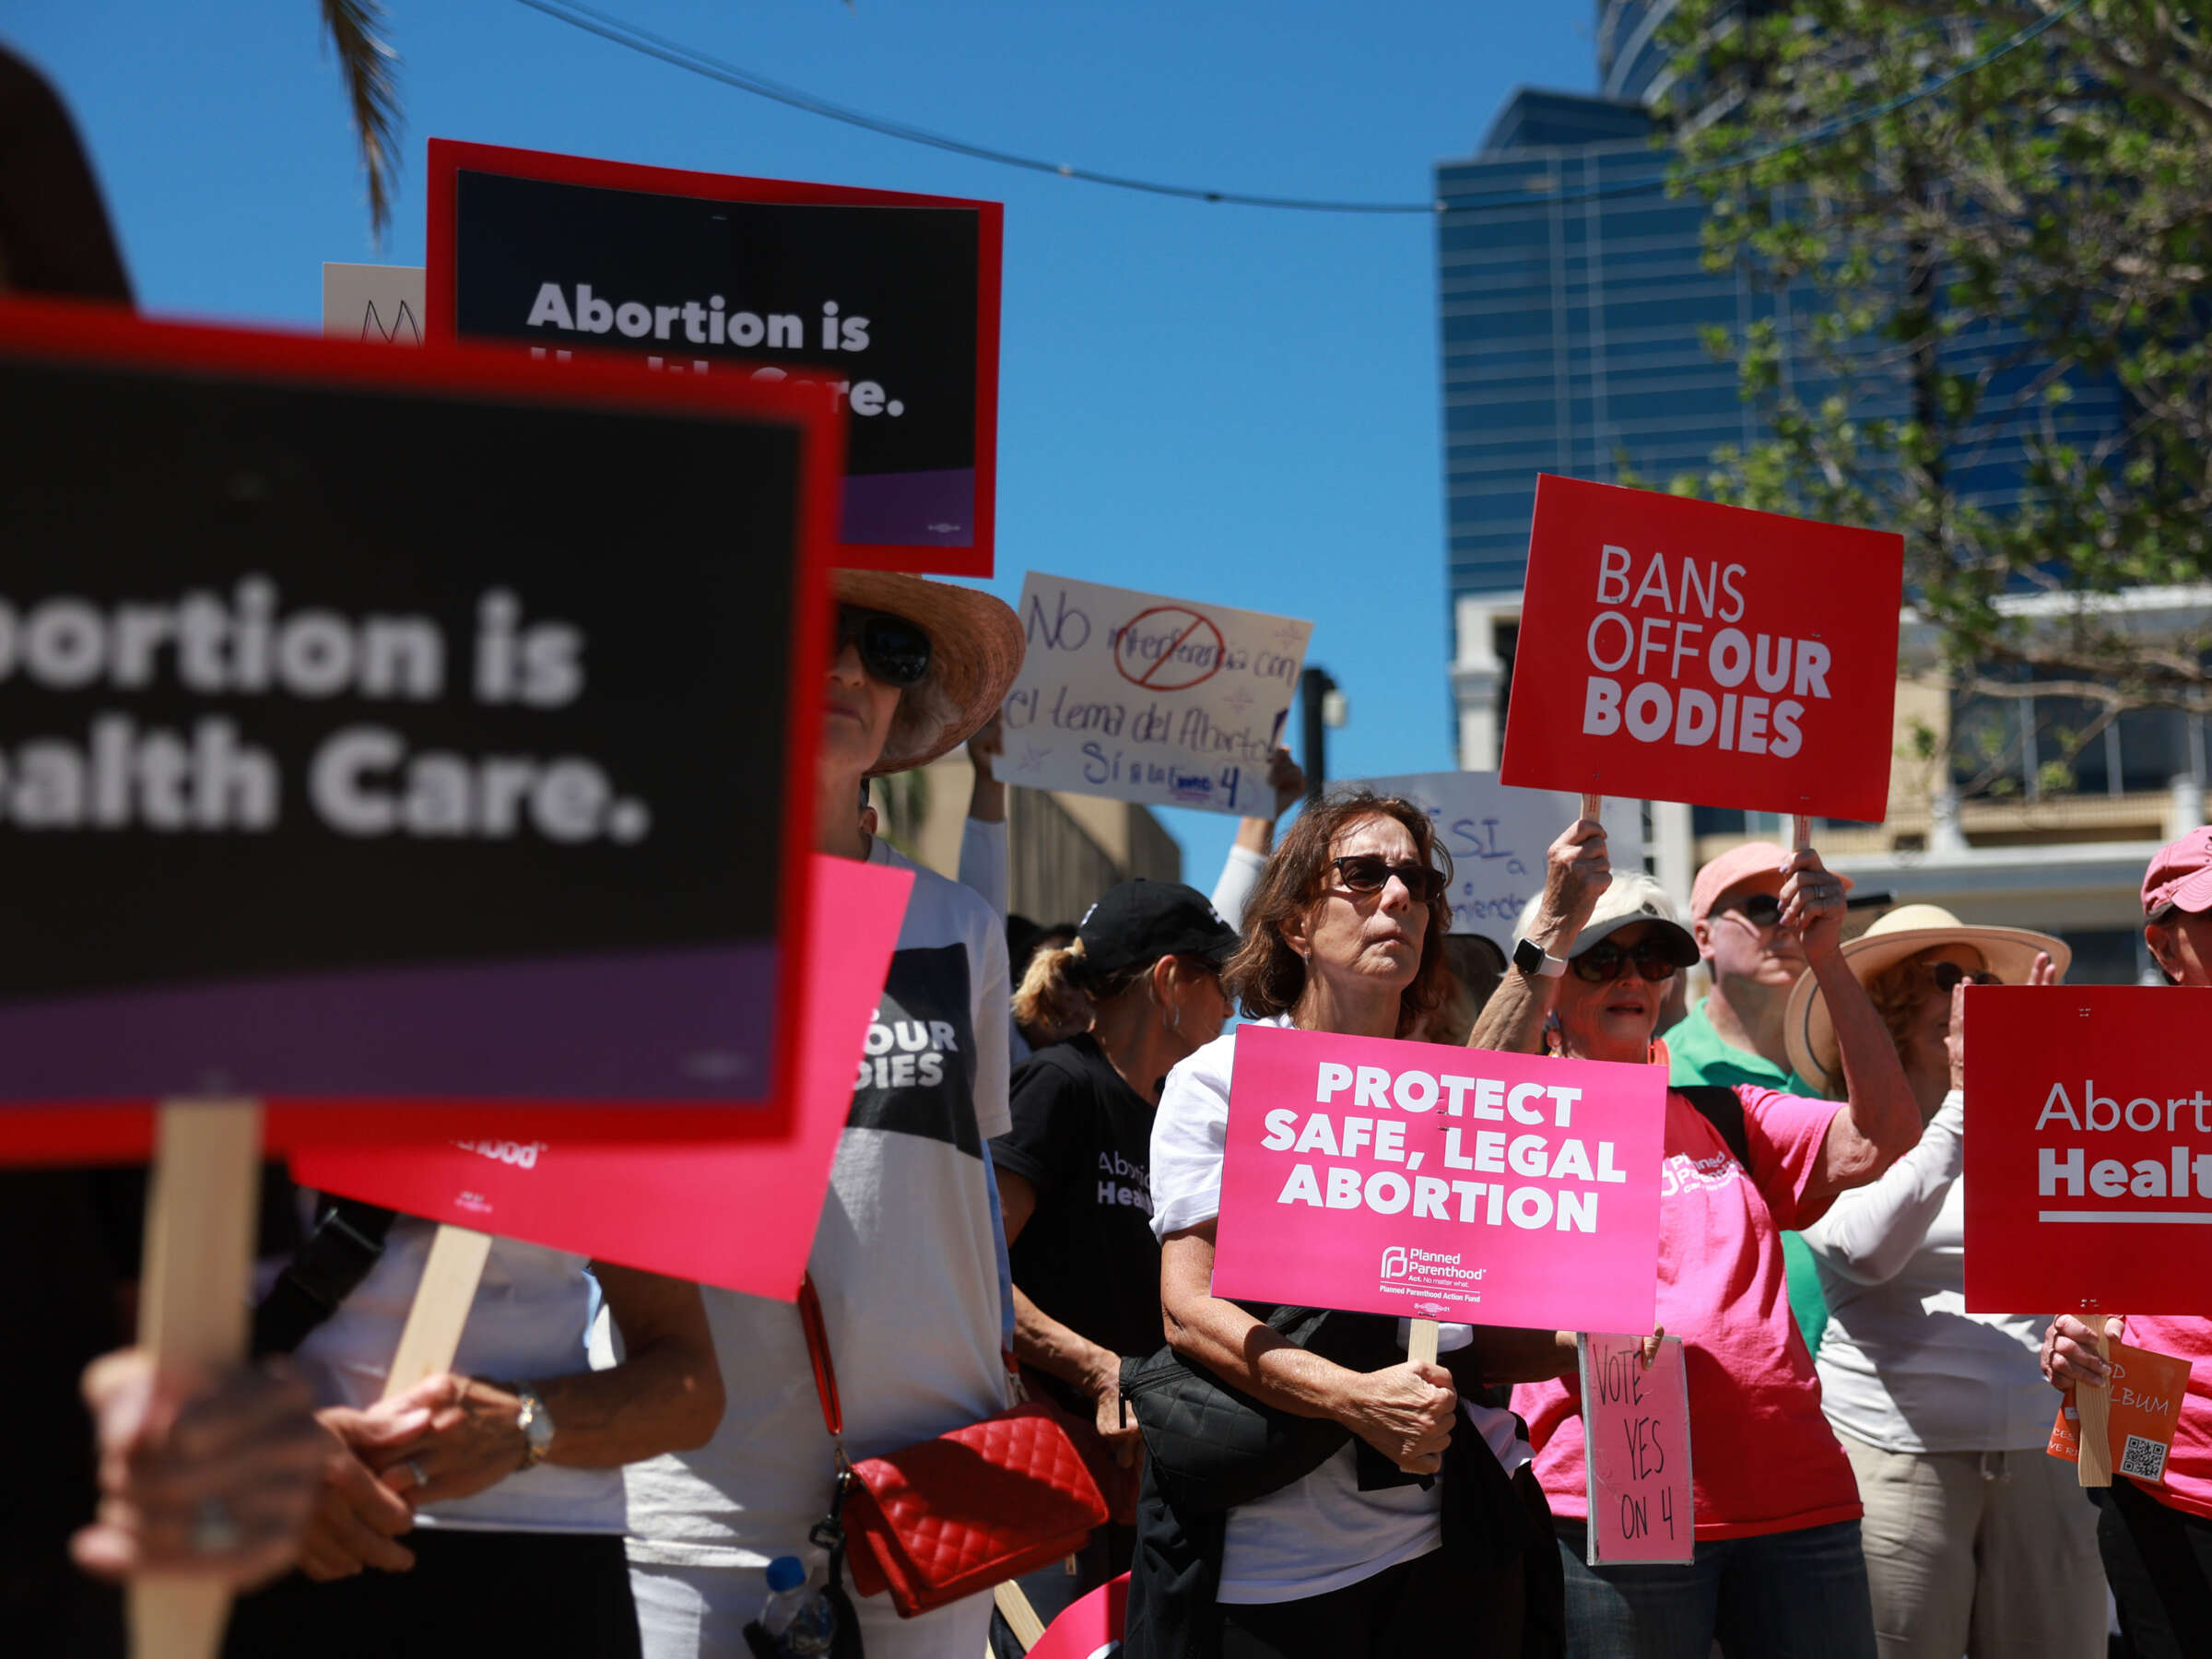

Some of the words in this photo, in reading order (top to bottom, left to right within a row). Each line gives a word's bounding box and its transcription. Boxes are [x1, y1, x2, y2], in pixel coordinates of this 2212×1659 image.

[526, 282, 804, 349] Abortion
[823, 300, 870, 352] is
[1596, 544, 1747, 623] BANS
[476, 592, 582, 706] is
[1582, 676, 1806, 759] BODIES
[0, 717, 278, 829] alth
[309, 728, 649, 841] Care.
[1220, 766, 1240, 808] 4
[863, 1020, 959, 1055] OUR
[1316, 1061, 1583, 1128] PROTECT
[2034, 1079, 2212, 1133] Abort
[1260, 1108, 1426, 1171] SAFE,
[1443, 1126, 1628, 1183] LEGAL
[1277, 1163, 1599, 1234] ABORTION
[1410, 1248, 1461, 1265] Planned
[1379, 1285, 1406, 1295] Planned
[1406, 1288, 1442, 1299] Parenthood
[1442, 1292, 1464, 1301] Action
[1464, 1294, 1481, 1303] Fund
[1593, 1344, 1643, 1406] VOTE
[1624, 1417, 1665, 1481] YES
[1621, 1493, 1648, 1539] ON
[1661, 1486, 1675, 1541] 4
